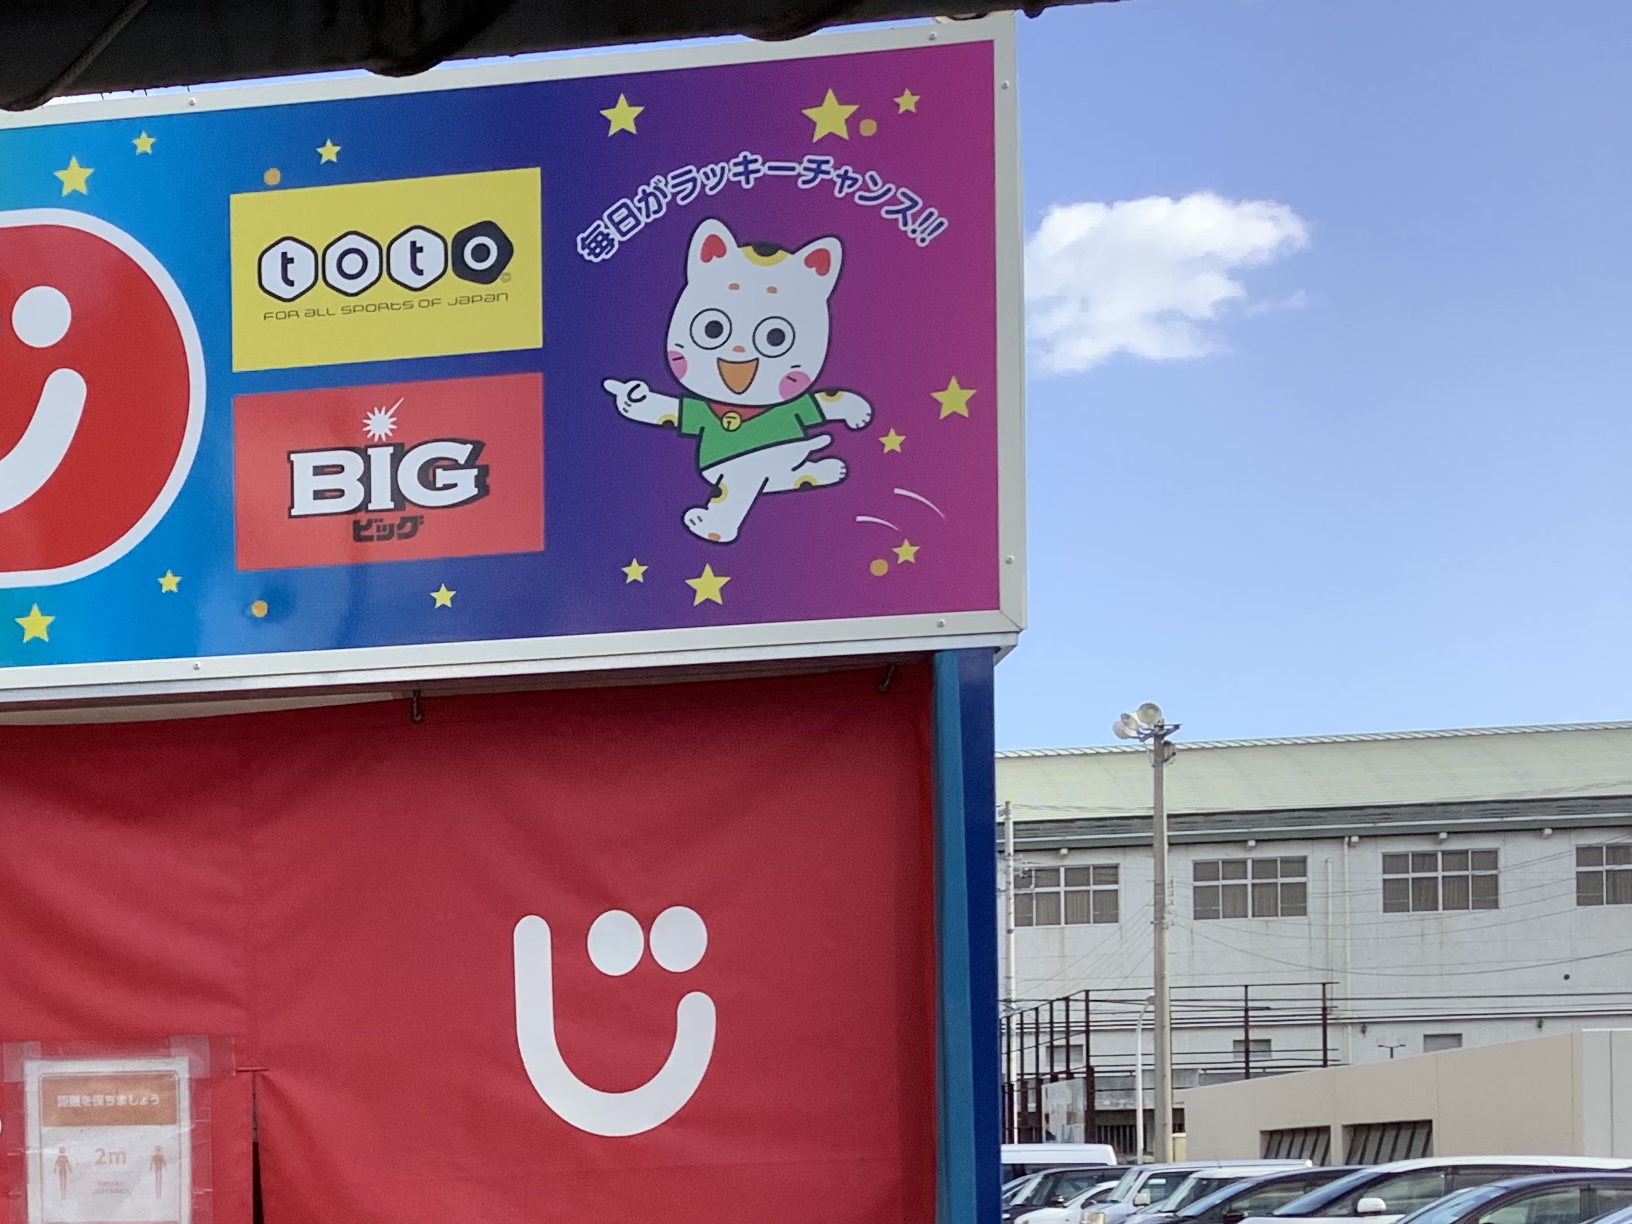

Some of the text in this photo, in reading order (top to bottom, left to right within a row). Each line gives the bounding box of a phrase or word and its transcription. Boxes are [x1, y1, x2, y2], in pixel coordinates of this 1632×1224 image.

[578, 153, 948, 262] 毎日がラッキーチャンス!!
[267, 227, 507, 296] toto
[287, 437, 490, 519] BIG
[352, 515, 425, 543] ビッグ
[513, 905, 717, 1138] じ
[94, 1147, 128, 1166] 2m
